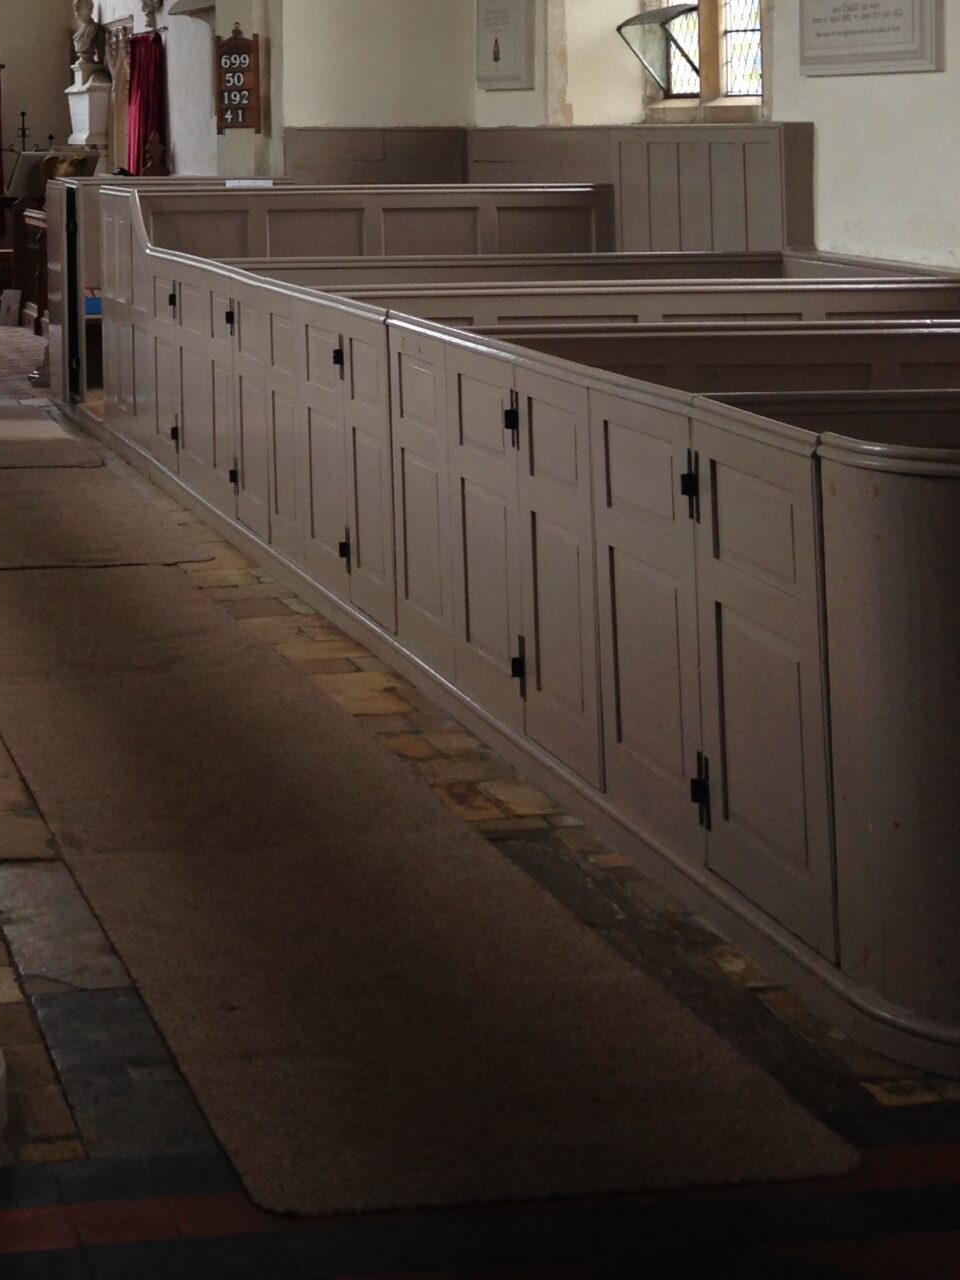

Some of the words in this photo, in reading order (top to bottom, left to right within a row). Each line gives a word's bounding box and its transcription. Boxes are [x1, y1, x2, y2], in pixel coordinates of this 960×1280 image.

[221, 54, 249, 68] 699
[225, 72, 244, 87] 50
[223, 90, 249, 105] 192
[224, 109, 243, 124] 41
